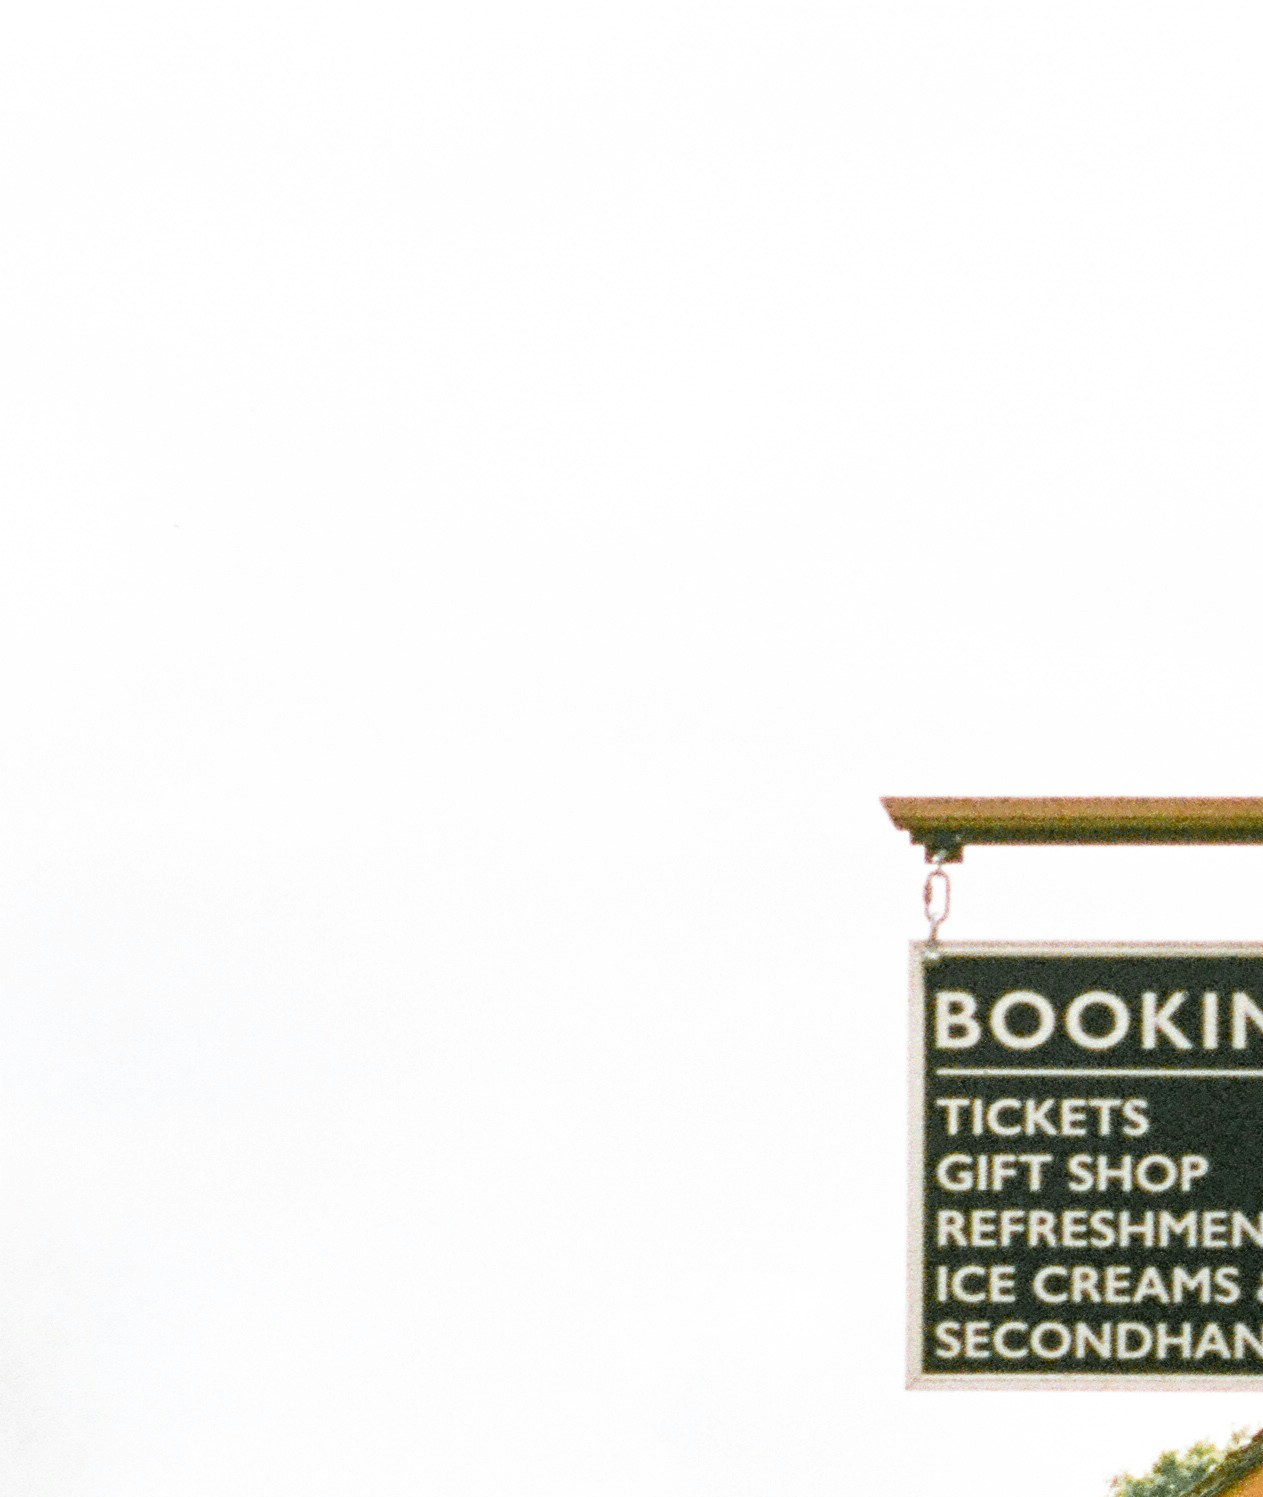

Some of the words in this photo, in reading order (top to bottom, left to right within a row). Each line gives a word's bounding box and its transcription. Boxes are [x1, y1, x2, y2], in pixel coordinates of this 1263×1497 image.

[935, 1097, 1151, 1138] TICKETS
[935, 1153, 1054, 1193] GIFT
[1067, 1153, 1210, 1193] SHOP
[936, 1209, 1263, 1250] REFRESHMEN
[936, 1264, 1017, 1304] ICE
[1032, 1265, 1242, 1304] CREAMS
[934, 1320, 1263, 1361] SECONDHAN
